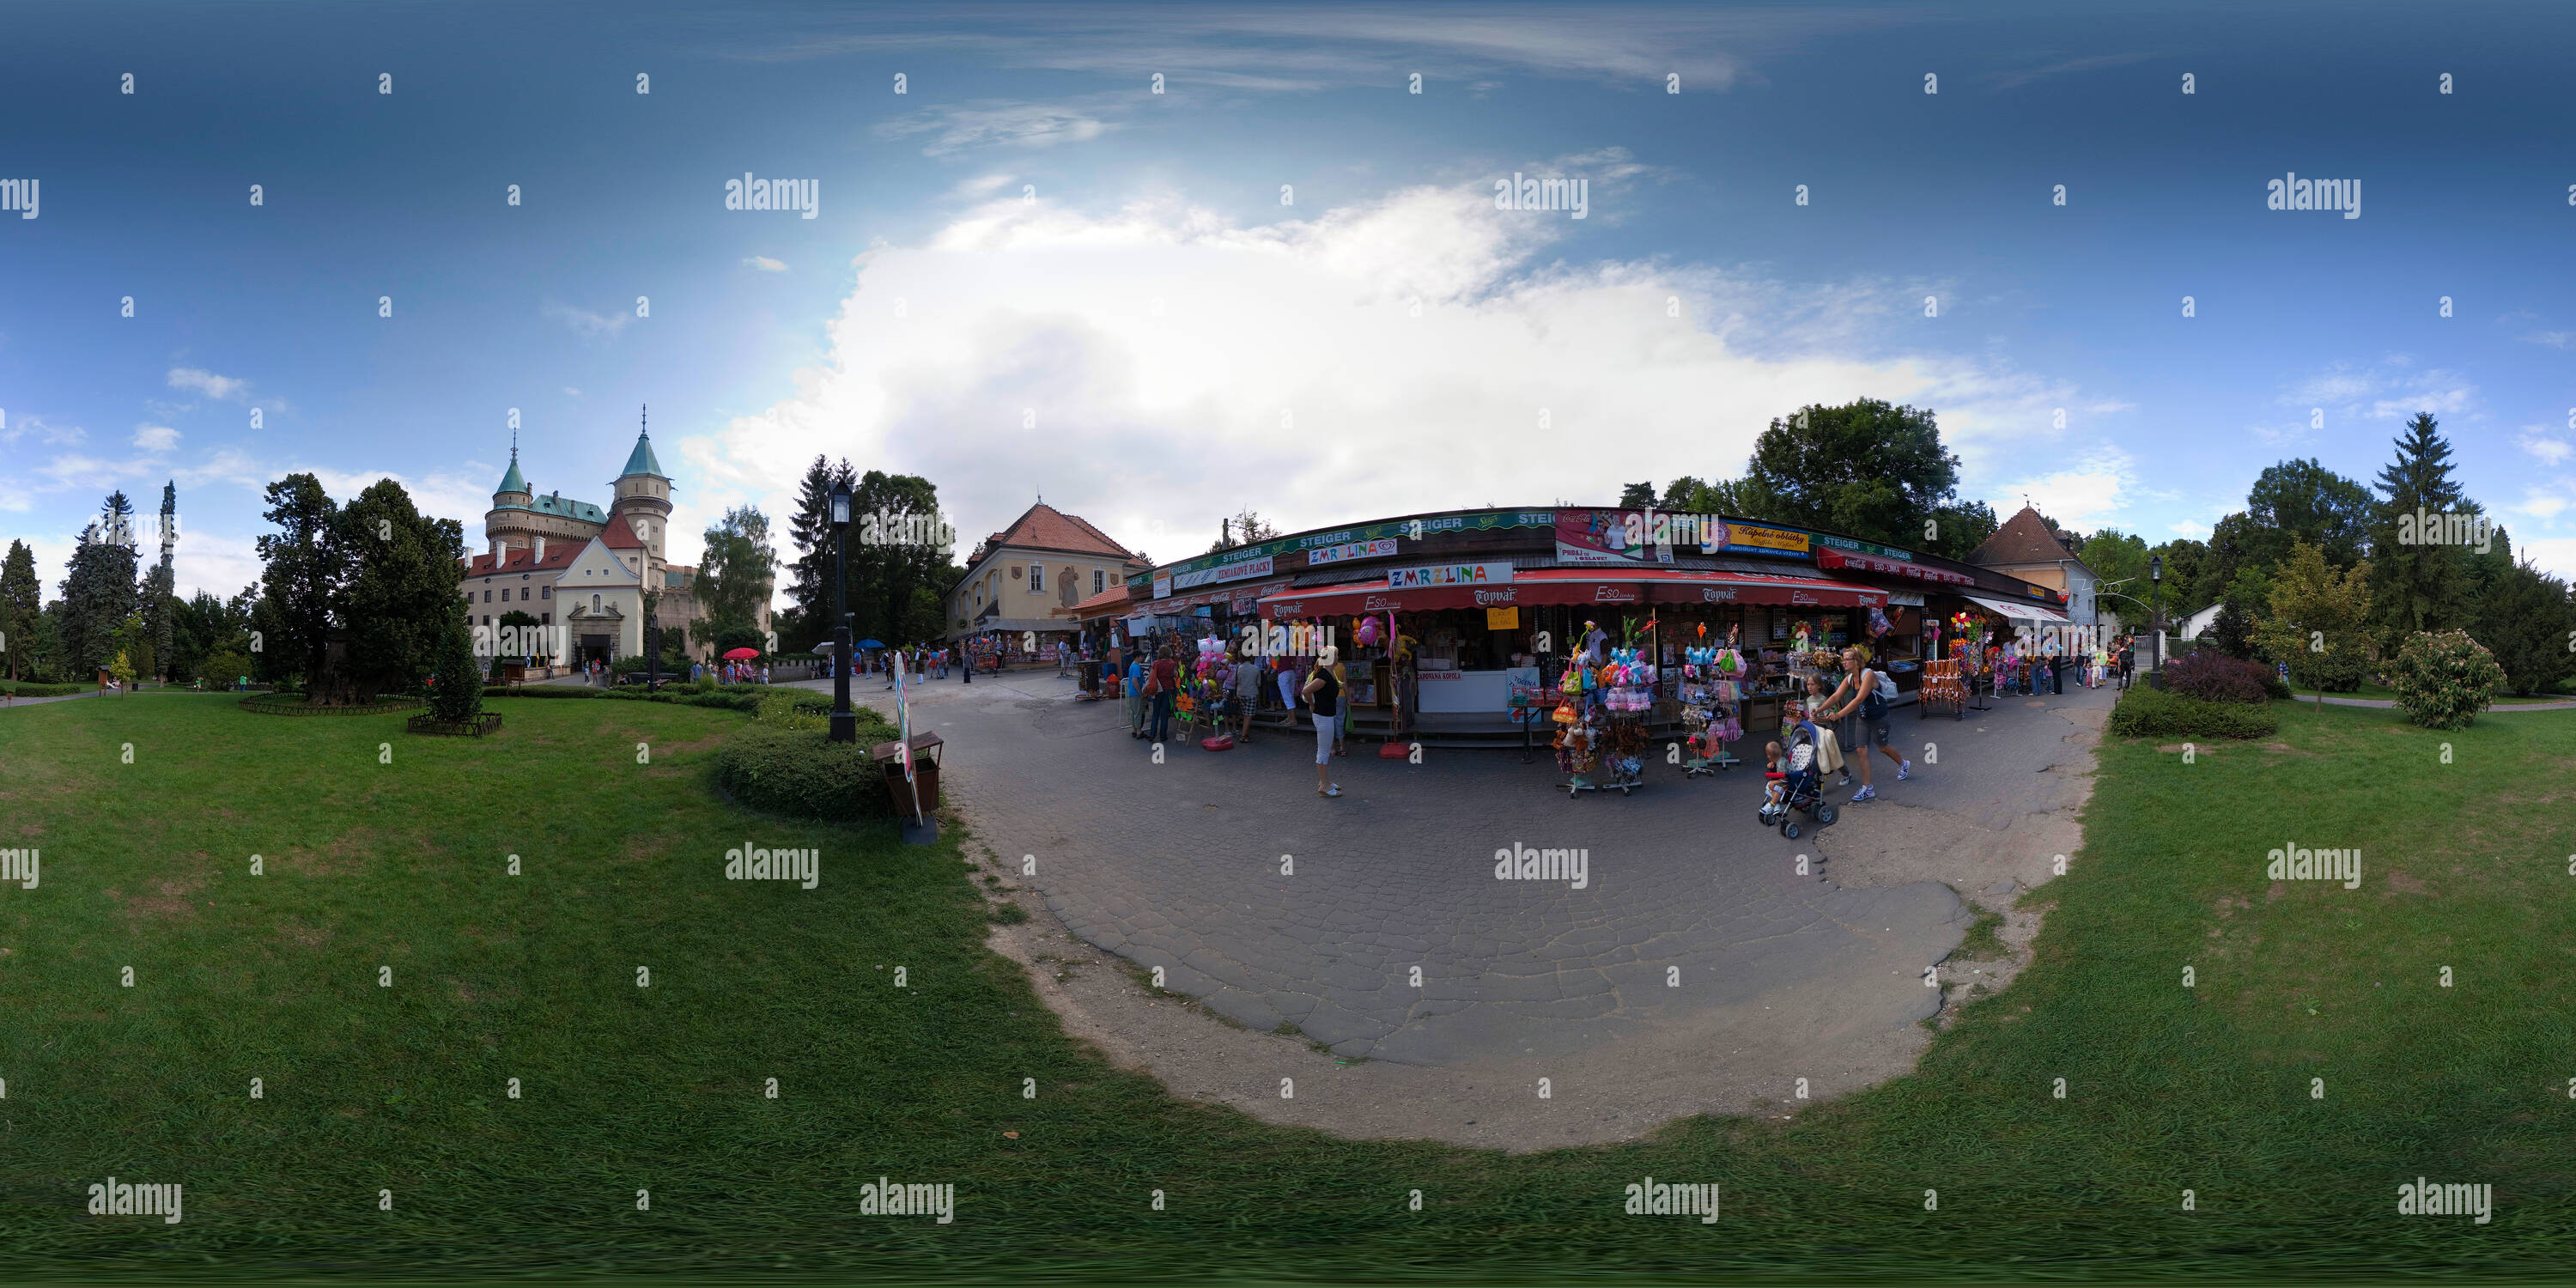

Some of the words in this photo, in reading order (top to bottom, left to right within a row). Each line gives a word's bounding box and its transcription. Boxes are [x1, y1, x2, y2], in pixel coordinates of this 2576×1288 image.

[1299, 531, 1351, 547] STEIGER
[1776, 532, 1805, 544] oblátky
[1824, 536, 1859, 550] STEIGER
[1223, 547, 1261, 562] STEIGER
[1311, 543, 1378, 563] ZMRZLINA
[1884, 548, 1911, 560] STEIGER
[1218, 564, 1248, 580] ZEMIAKOVÉ
[1249, 561, 1271, 574] PLACKY
[1390, 566, 1487, 586] ZMRZLINA
